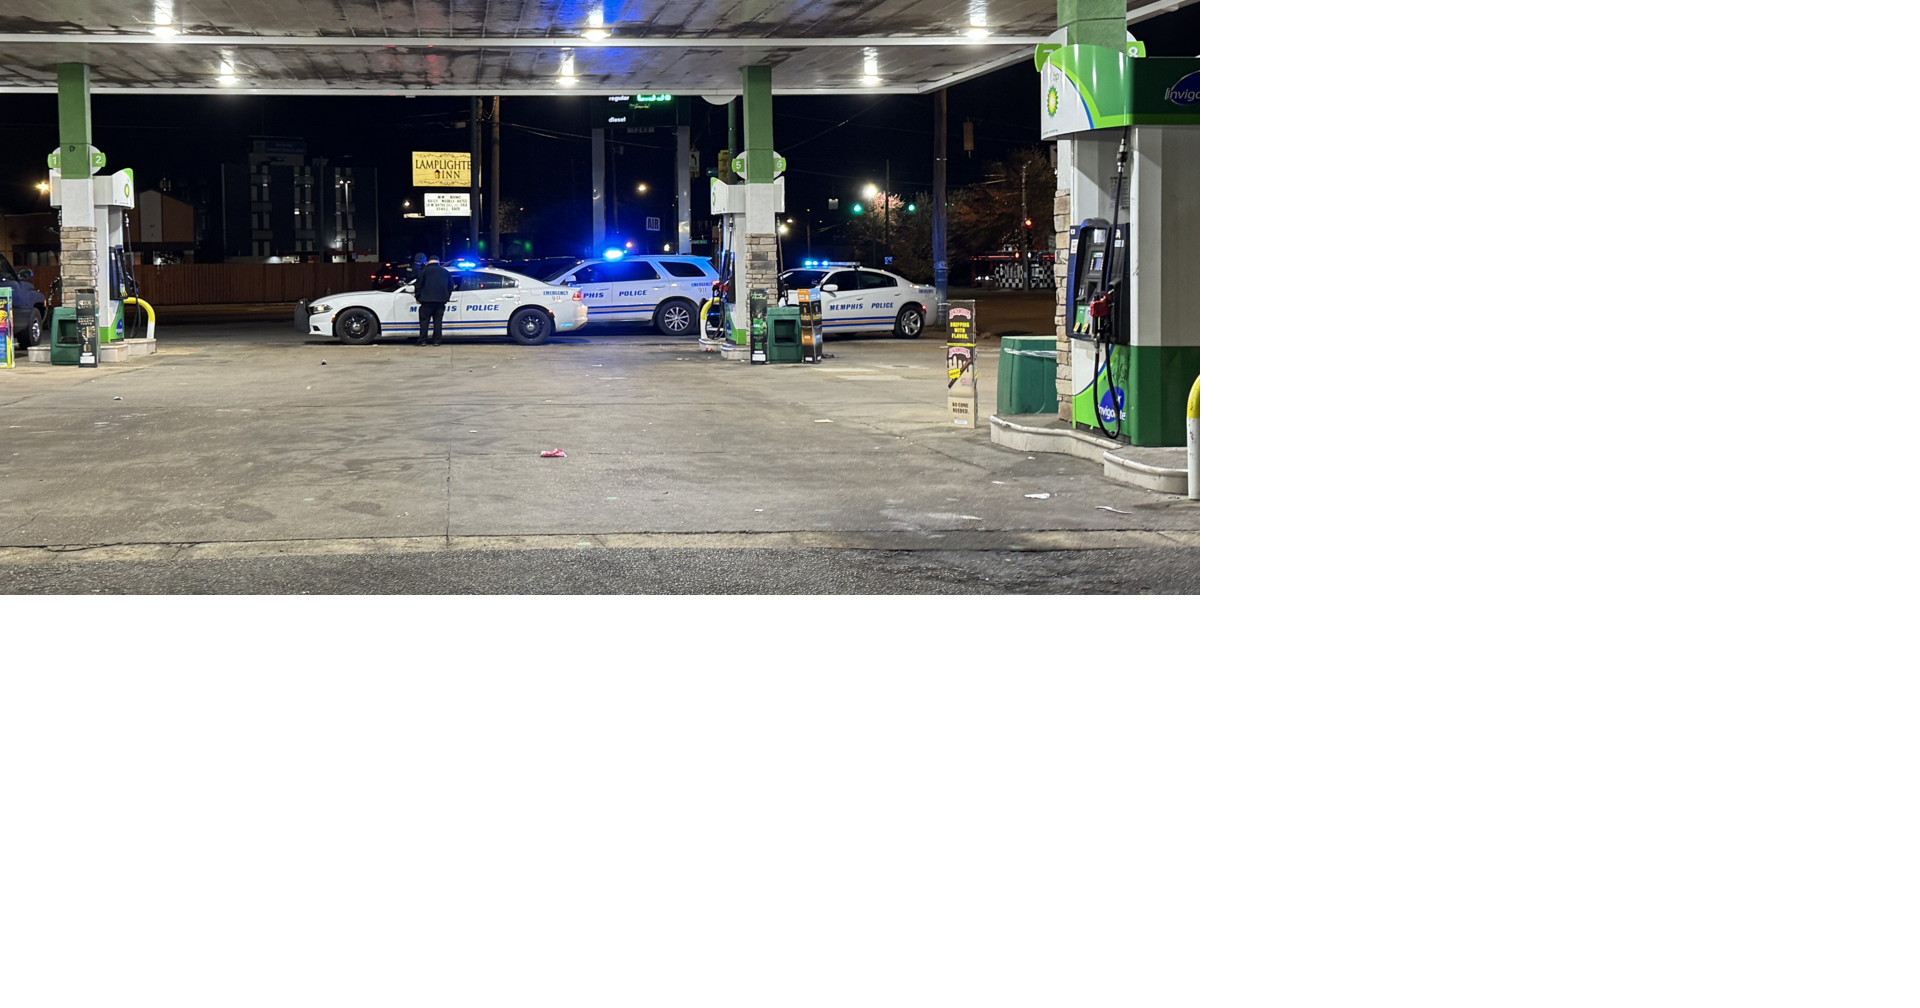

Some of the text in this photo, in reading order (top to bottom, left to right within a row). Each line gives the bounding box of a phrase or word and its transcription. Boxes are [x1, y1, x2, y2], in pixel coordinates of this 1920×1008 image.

[52, 156, 57, 165] 1
[95, 155, 102, 164] 2
[736, 161, 742, 169] 5
[776, 161, 782, 169] 6
[442, 170, 461, 179] INN
[647, 217, 659, 230] AIR
[618, 289, 648, 297] POLICE
[829, 302, 864, 311] MEMPHIS
